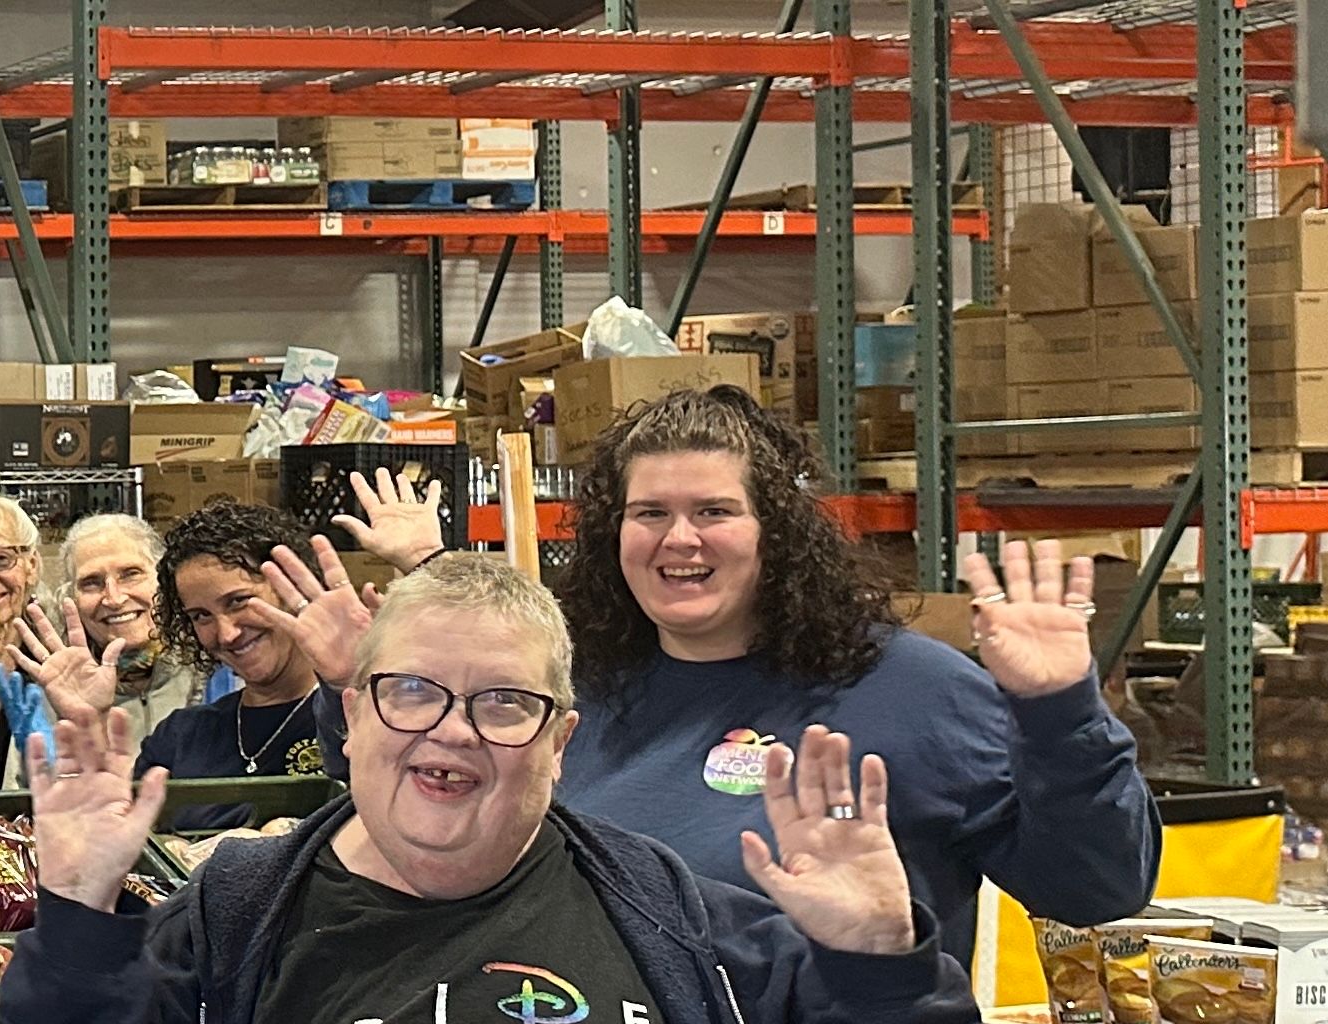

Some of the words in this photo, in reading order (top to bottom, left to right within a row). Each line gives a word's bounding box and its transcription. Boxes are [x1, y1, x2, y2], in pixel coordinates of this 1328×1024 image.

[767, 216, 780, 231] D
[160, 437, 215, 447] MINIGRIP
[716, 759, 767, 776] FOO
